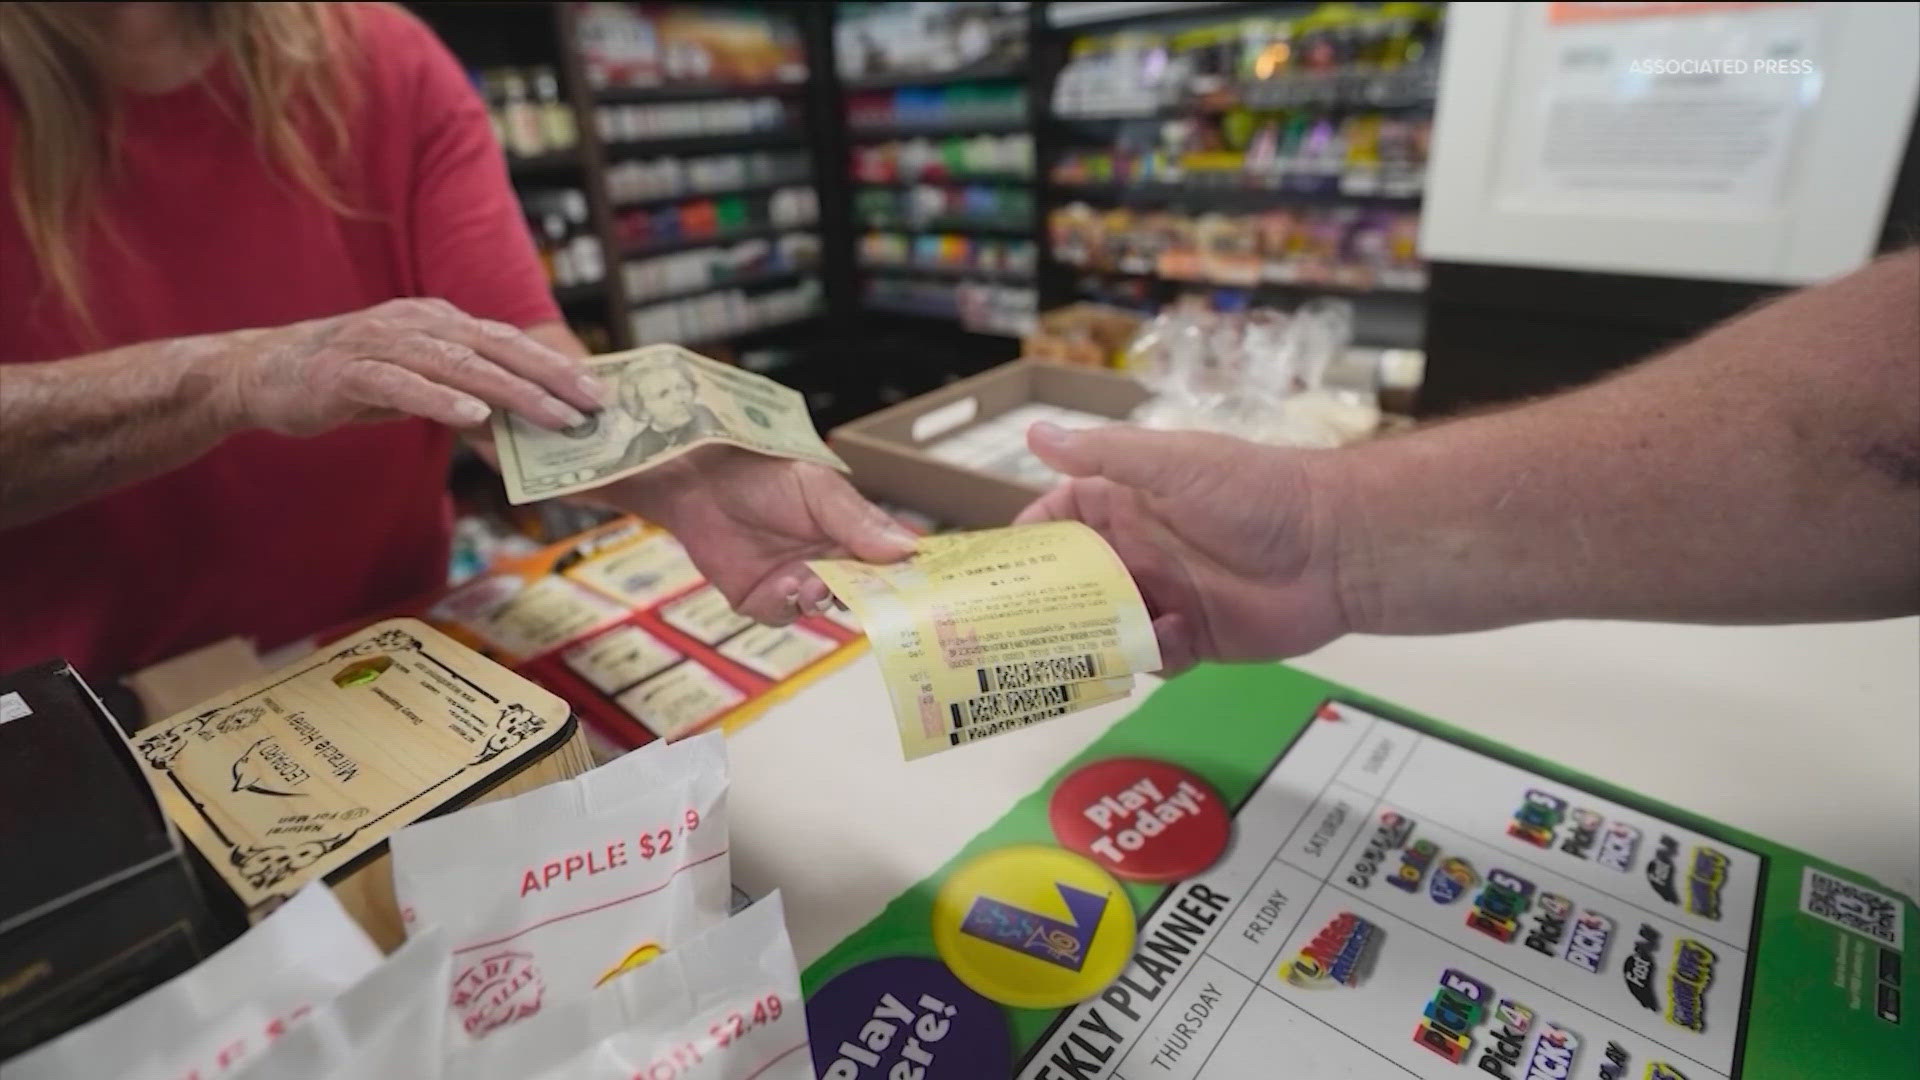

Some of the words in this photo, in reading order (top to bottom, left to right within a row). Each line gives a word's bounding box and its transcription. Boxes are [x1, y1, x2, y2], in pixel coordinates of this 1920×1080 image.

[283, 711, 324, 747] Honey
[258, 743, 311, 786] LEOPARD
[314, 740, 360, 784] Miracle
[266, 823, 324, 837] Natural
[1083, 777, 1163, 830] Play
[1090, 780, 1206, 863] Today!
[1304, 801, 1350, 858] SATURDAY
[520, 842, 628, 899] APPLE
[1242, 889, 1291, 944] FRIDAY
[1102, 883, 1230, 1022] PLANNER
[1624, 954, 1650, 988] Fast
[1151, 981, 1223, 1072] THURSDAY
